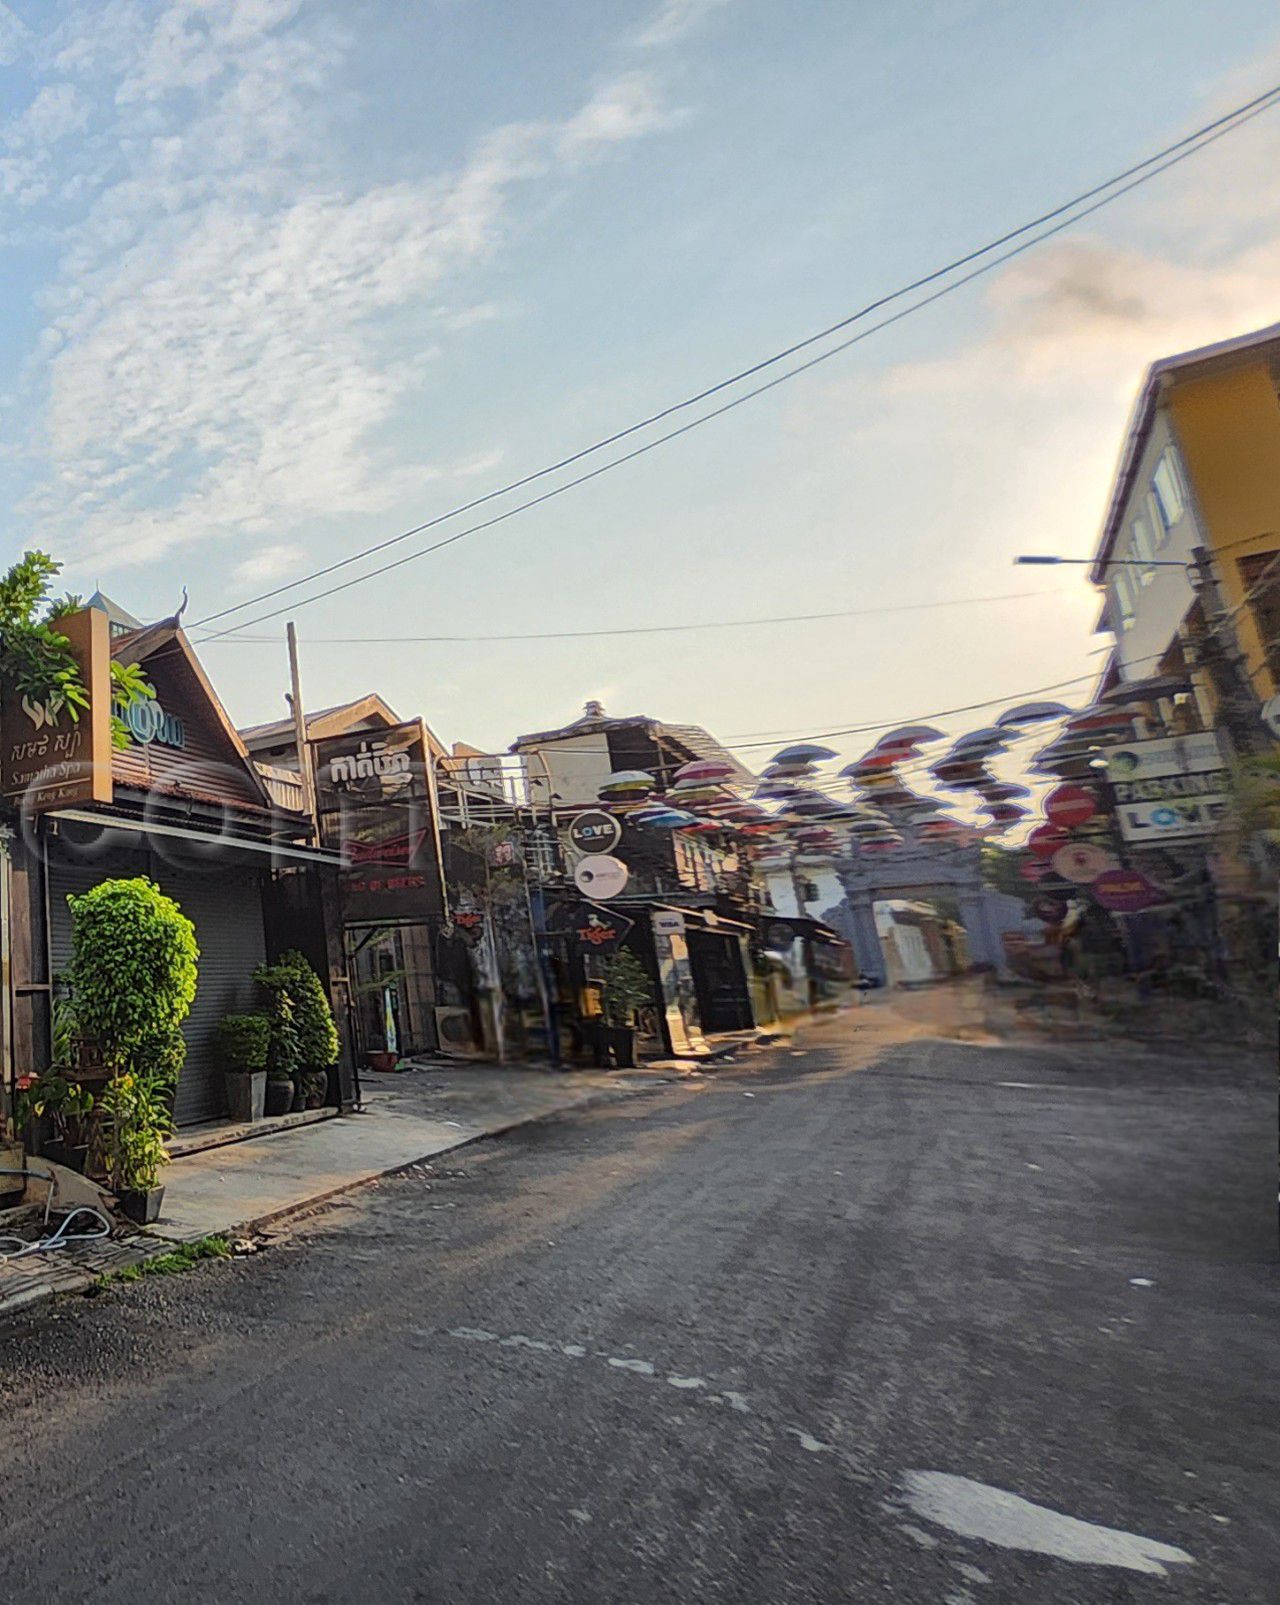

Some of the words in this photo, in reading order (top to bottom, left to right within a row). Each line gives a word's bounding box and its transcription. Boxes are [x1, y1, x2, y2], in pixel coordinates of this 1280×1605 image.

[60, 761, 81, 779] Spa
[573, 823, 615, 839] LOVE
[577, 927, 617, 945] Tiger
